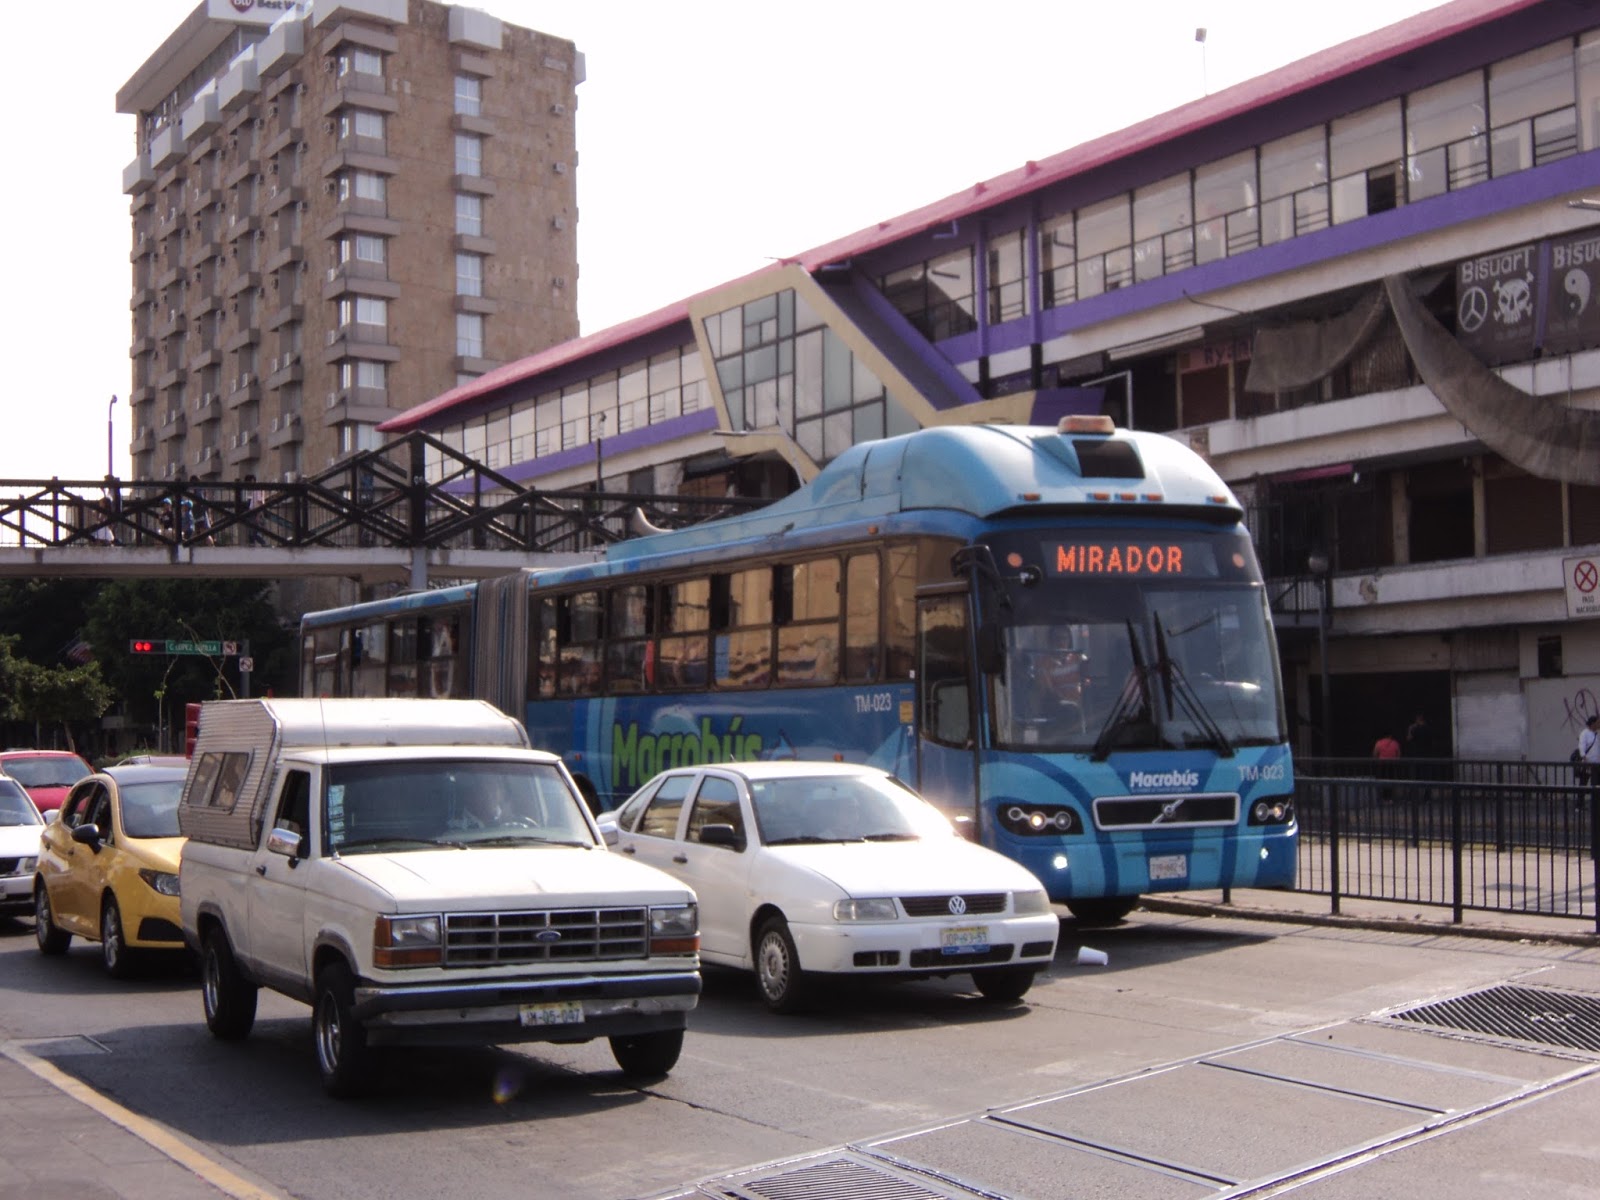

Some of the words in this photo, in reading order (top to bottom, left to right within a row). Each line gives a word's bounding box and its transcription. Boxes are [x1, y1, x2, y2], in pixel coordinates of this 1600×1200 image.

[1057, 545, 1183, 573] MIRADOR
[855, 694, 892, 713] TM-023
[1130, 769, 1199, 787] Macrobús
[1238, 765, 1285, 781] TM-023
